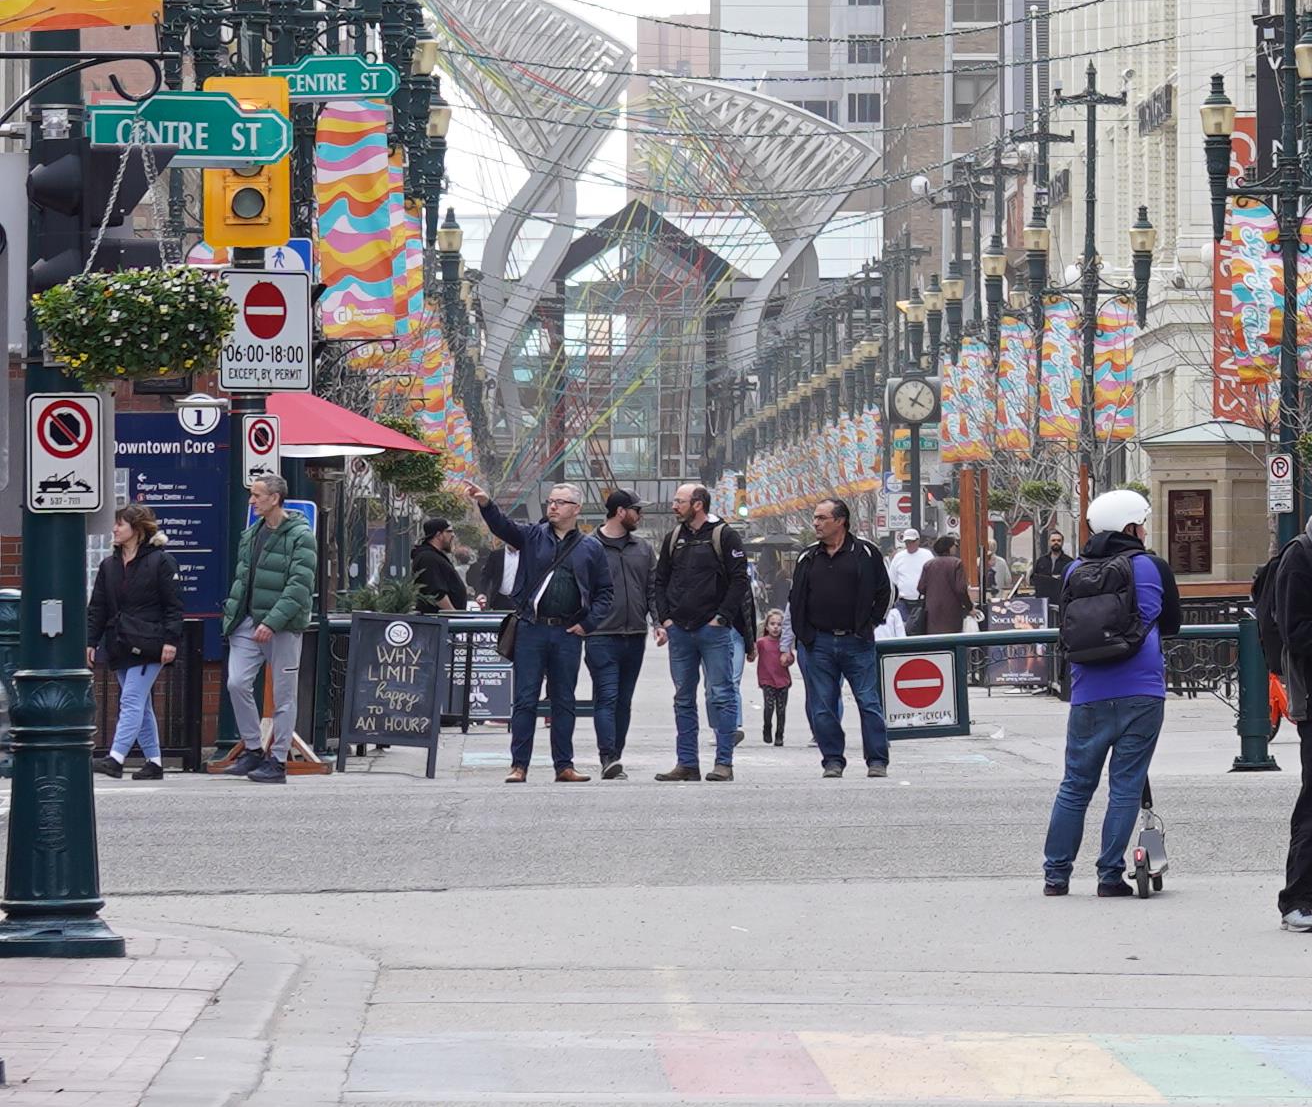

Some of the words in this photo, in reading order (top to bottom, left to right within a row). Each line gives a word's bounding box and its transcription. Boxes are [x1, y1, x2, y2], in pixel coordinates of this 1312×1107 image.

[286, 72, 347, 93] CENTRE
[361, 72, 381, 92] ST
[231, 122, 262, 152] ST
[225, 344, 304, 363] 06:00-18:00
[228, 368, 258, 380] EXCEPT
[261, 368, 272, 380] BY
[275, 368, 302, 380] PERMIT
[194, 409, 204, 426] 1
[184, 440, 215, 454] Core
[376, 645, 421, 664] WHY
[368, 665, 420, 684] LIMIT
[376, 681, 420, 712] happy
[355, 716, 376, 731] AN
[384, 717, 430, 733] HOUR?
